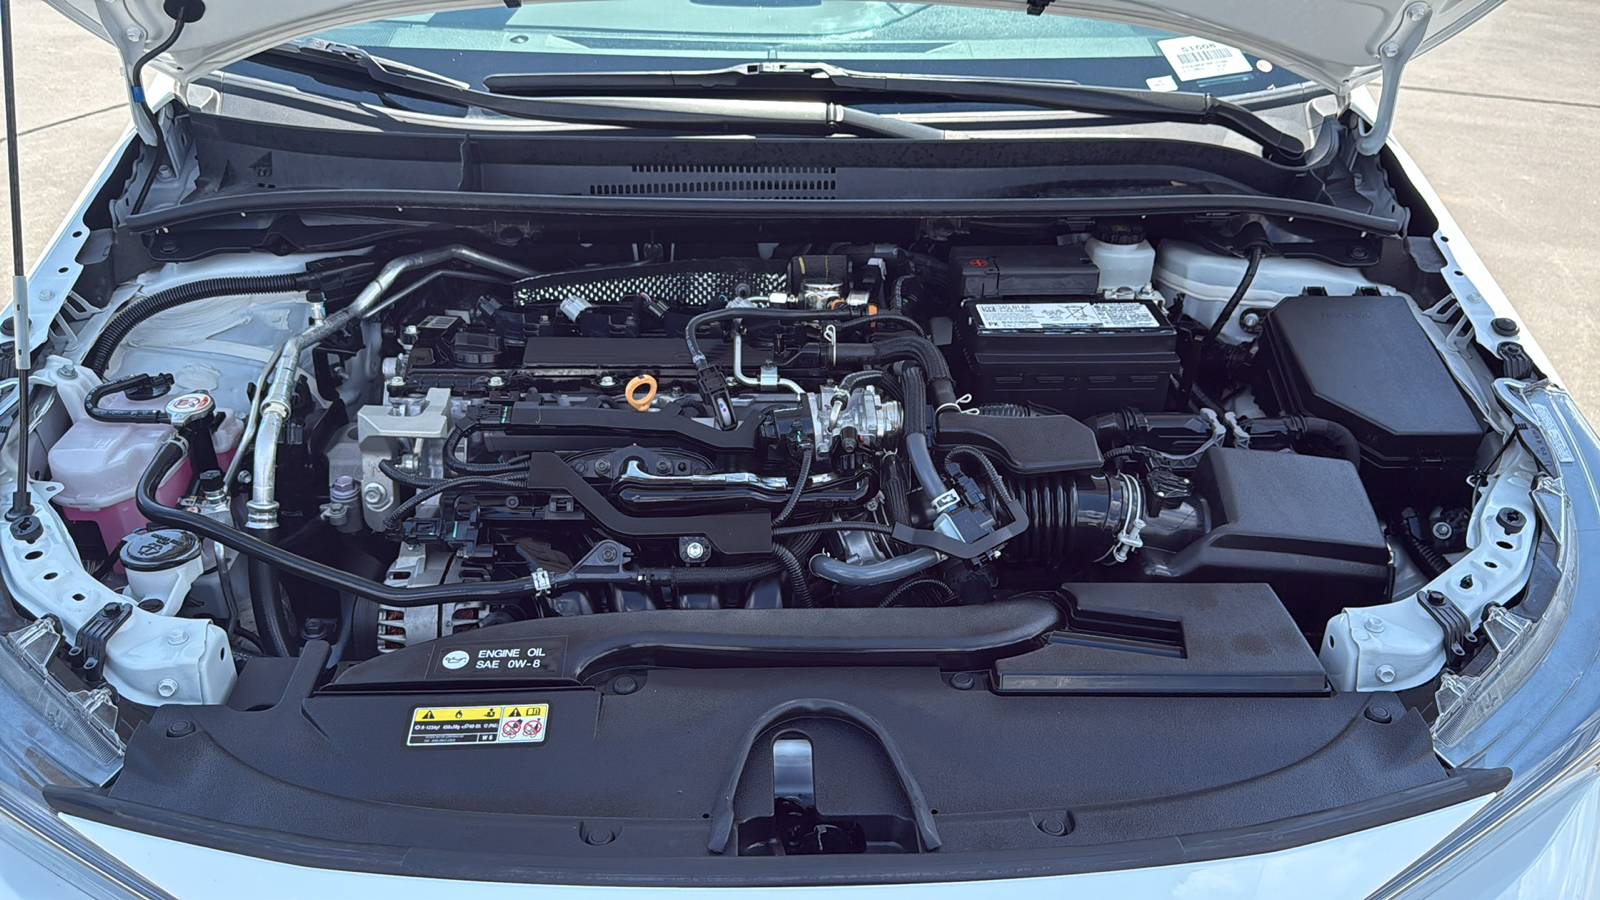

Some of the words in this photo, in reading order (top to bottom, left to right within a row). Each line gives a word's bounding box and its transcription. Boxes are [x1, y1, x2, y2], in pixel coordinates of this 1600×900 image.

[478, 648, 521, 659] ENGINE
[527, 647, 546, 657] OIL
[475, 660, 500, 669] SAE
[507, 659, 541, 669] 0W-8
